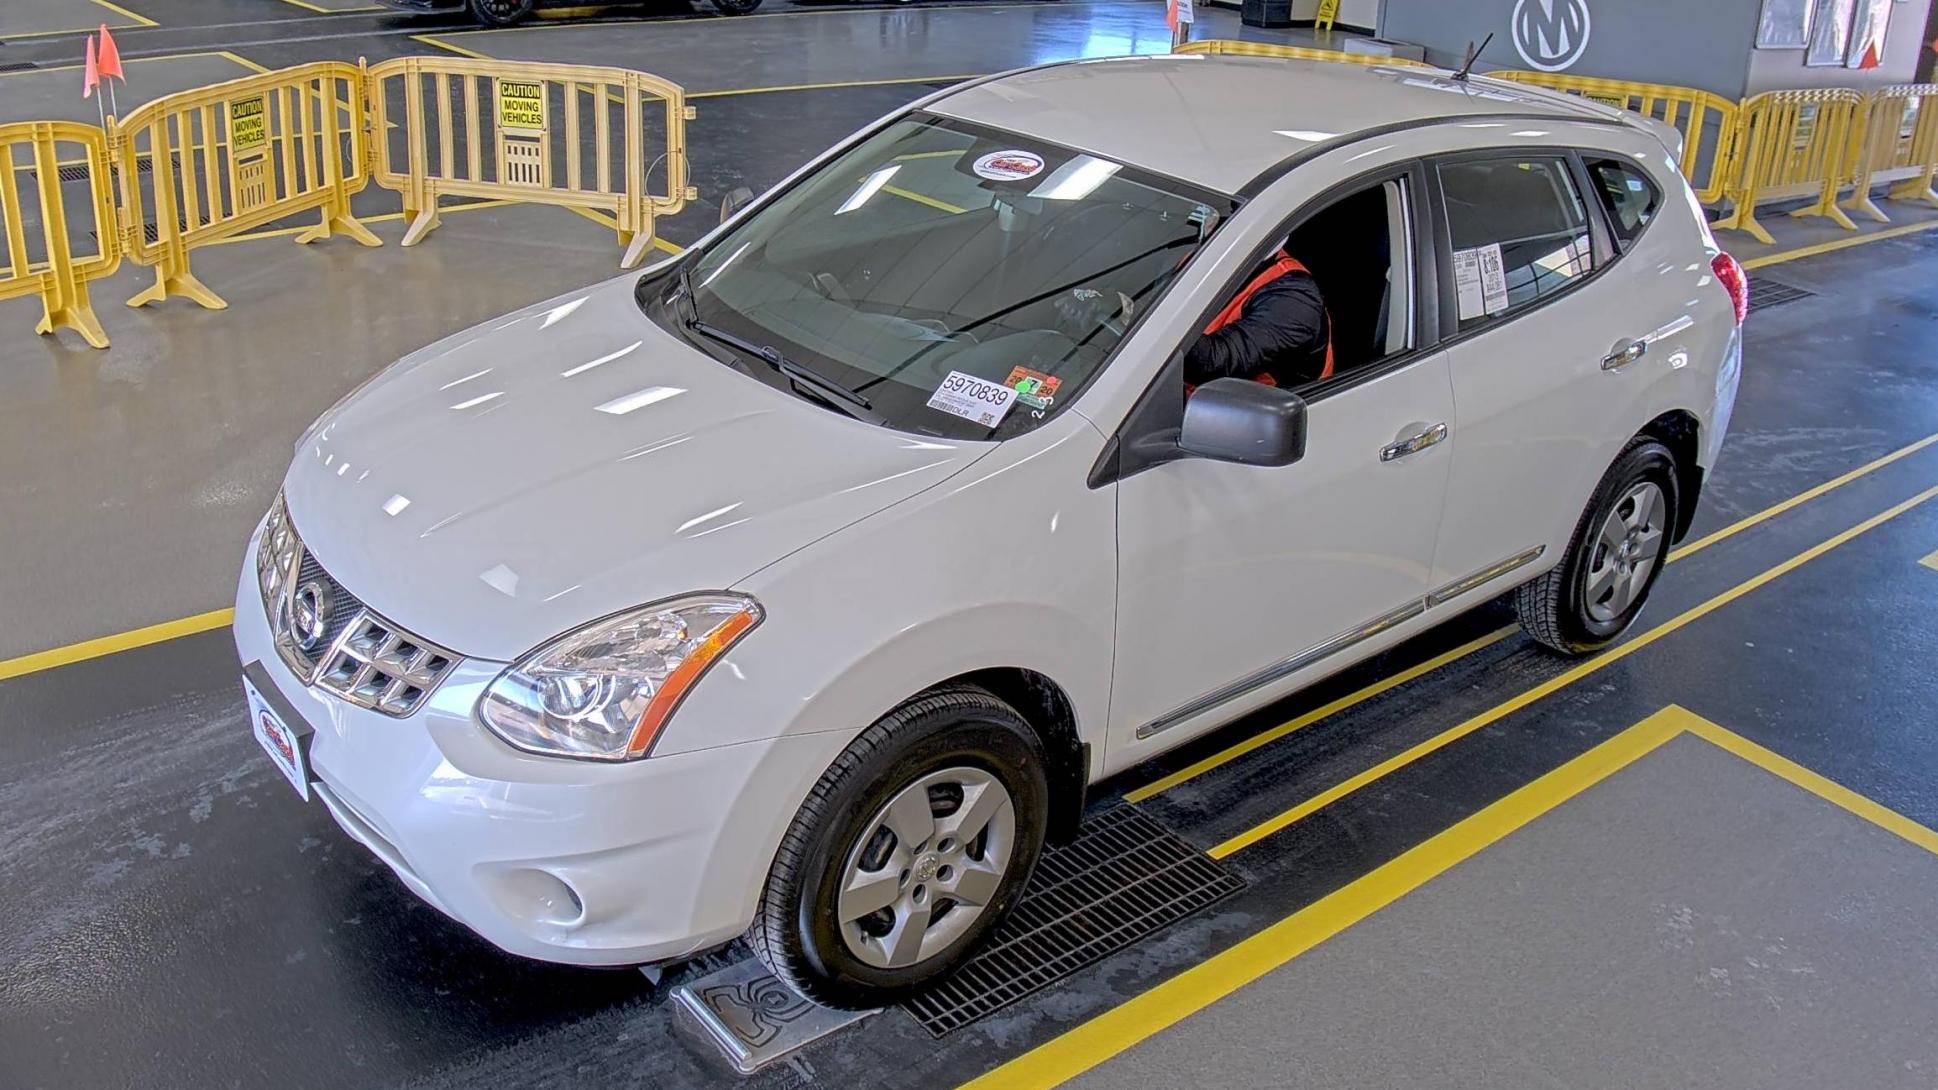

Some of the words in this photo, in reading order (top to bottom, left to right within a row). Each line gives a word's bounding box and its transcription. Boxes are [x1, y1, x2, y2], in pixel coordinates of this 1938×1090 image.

[502, 83, 540, 98] CAUTION
[232, 100, 262, 118] CAUTION
[504, 100, 539, 112] MOVING
[235, 117, 262, 132] MOVING
[502, 112, 542, 124] VEHICLES
[233, 129, 264, 146] VEHICLES
[943, 375, 1009, 406] 5970839
